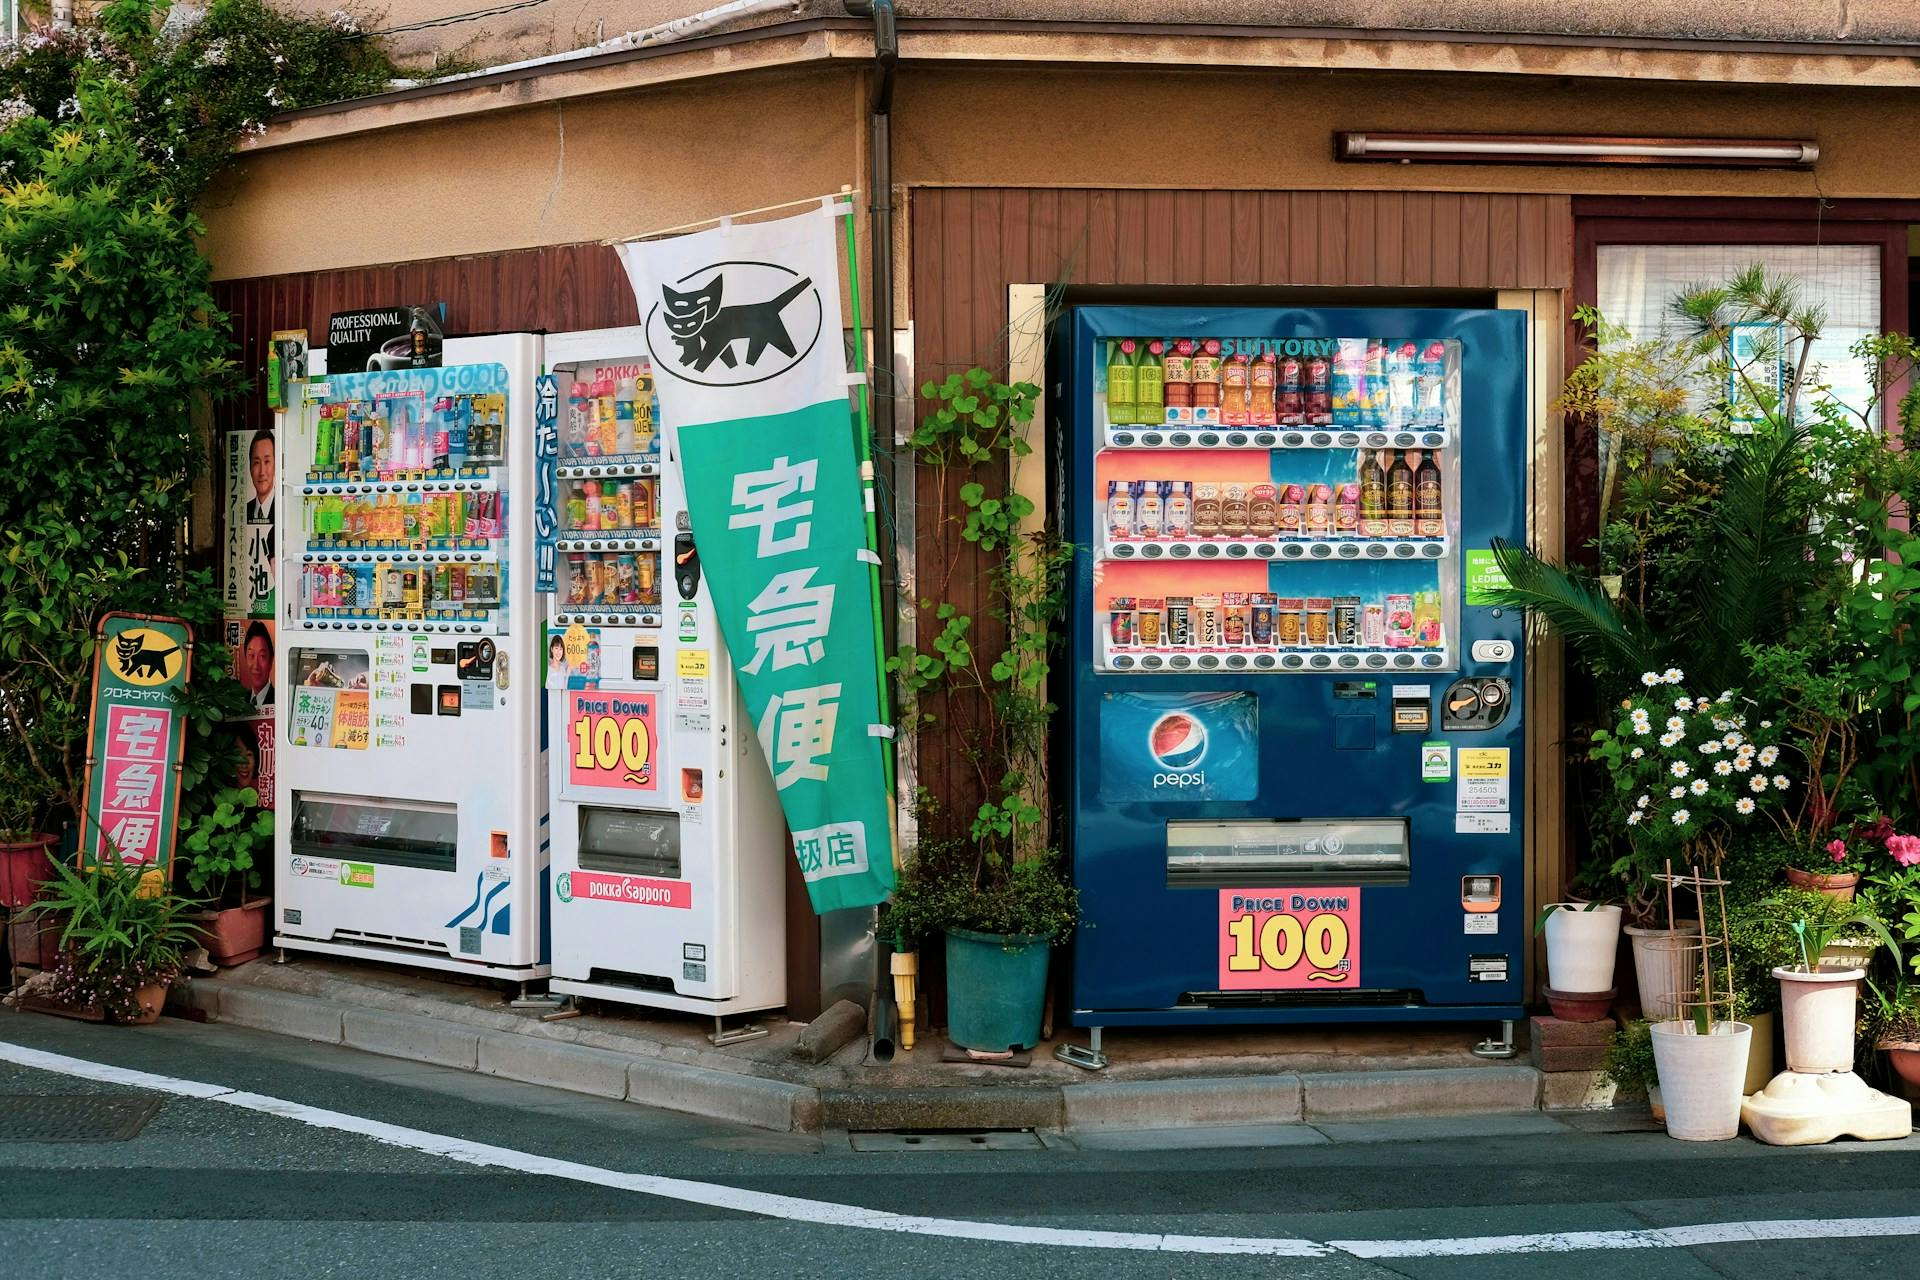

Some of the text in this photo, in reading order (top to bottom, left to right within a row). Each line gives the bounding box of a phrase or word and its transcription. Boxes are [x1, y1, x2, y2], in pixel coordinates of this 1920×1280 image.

[331, 311, 401, 330] PROFESSIONAL
[330, 329, 372, 346] QUALITY
[1221, 338, 1335, 357] SUNTORY
[595, 365, 640, 381] POKKA
[228, 434, 240, 601] 都民ファーストの会
[248, 527, 270, 601] 小池
[727, 456, 843, 792] 宅急便
[1178, 609, 1188, 644] BLACK
[1205, 610, 1215, 642] BOSS
[1345, 608, 1355, 644] BLACK
[299, 694, 311, 714] 茶
[310, 704, 331, 714] カテキン
[577, 697, 648, 716] PRICE DOWN
[310, 715, 325, 731] 40
[109, 712, 164, 861] 宅急便
[1153, 770, 1205, 788] pepsi
[1231, 894, 1349, 913] PRICE DOWN
